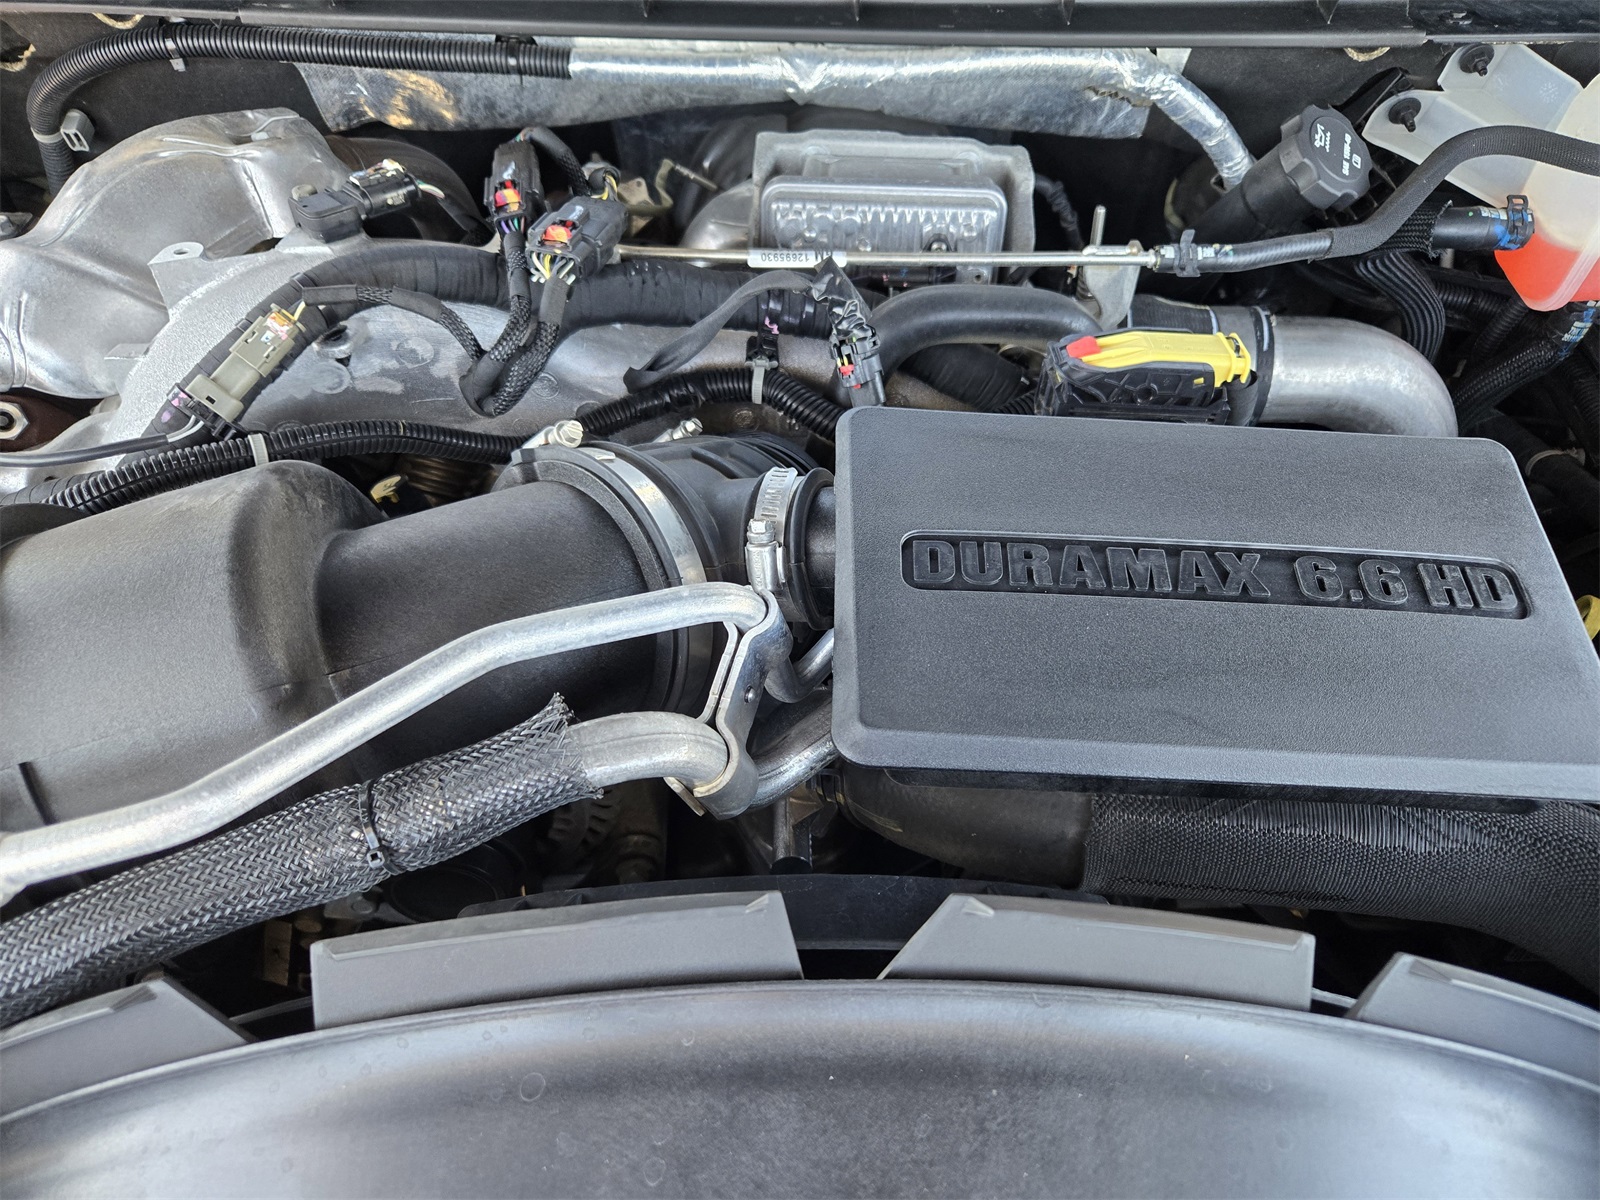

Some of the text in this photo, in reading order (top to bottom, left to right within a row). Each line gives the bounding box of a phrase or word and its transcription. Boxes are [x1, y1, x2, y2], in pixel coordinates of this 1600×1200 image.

[1342, 160, 1350, 176] SAE
[761, 252, 809, 262] 12695930
[913, 540, 1519, 613] DURAMAX 6.6 HD
